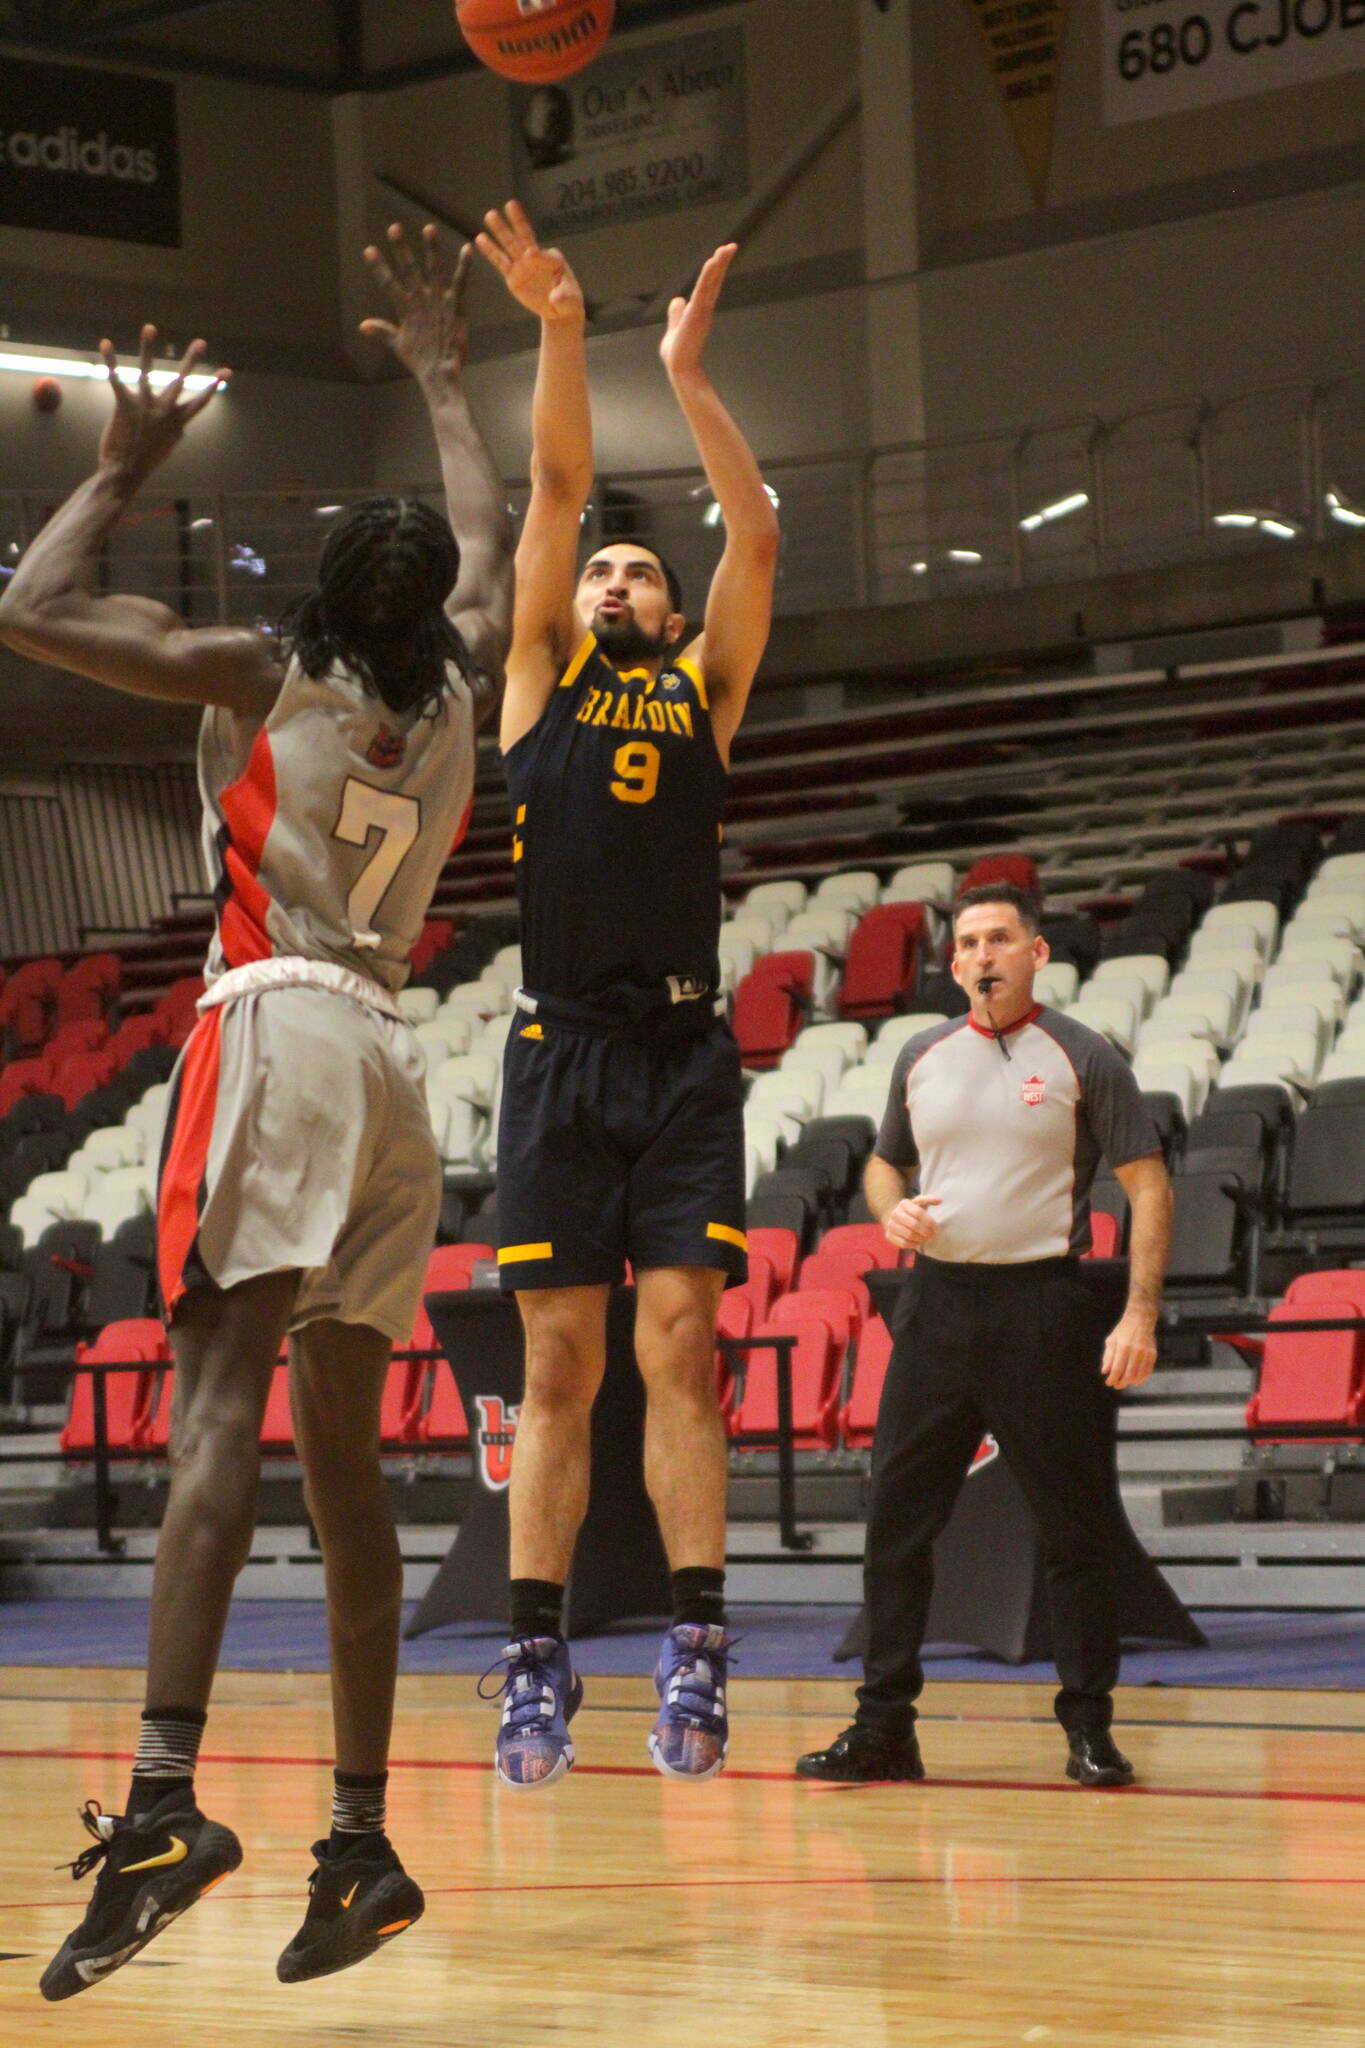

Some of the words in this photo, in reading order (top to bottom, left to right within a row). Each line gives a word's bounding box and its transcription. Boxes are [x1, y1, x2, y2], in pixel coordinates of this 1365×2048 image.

[1118, 15, 1212, 81] 680
[8, 124, 159, 183] adidas
[610, 741, 661, 804] 9
[332, 775, 421, 950] 7
